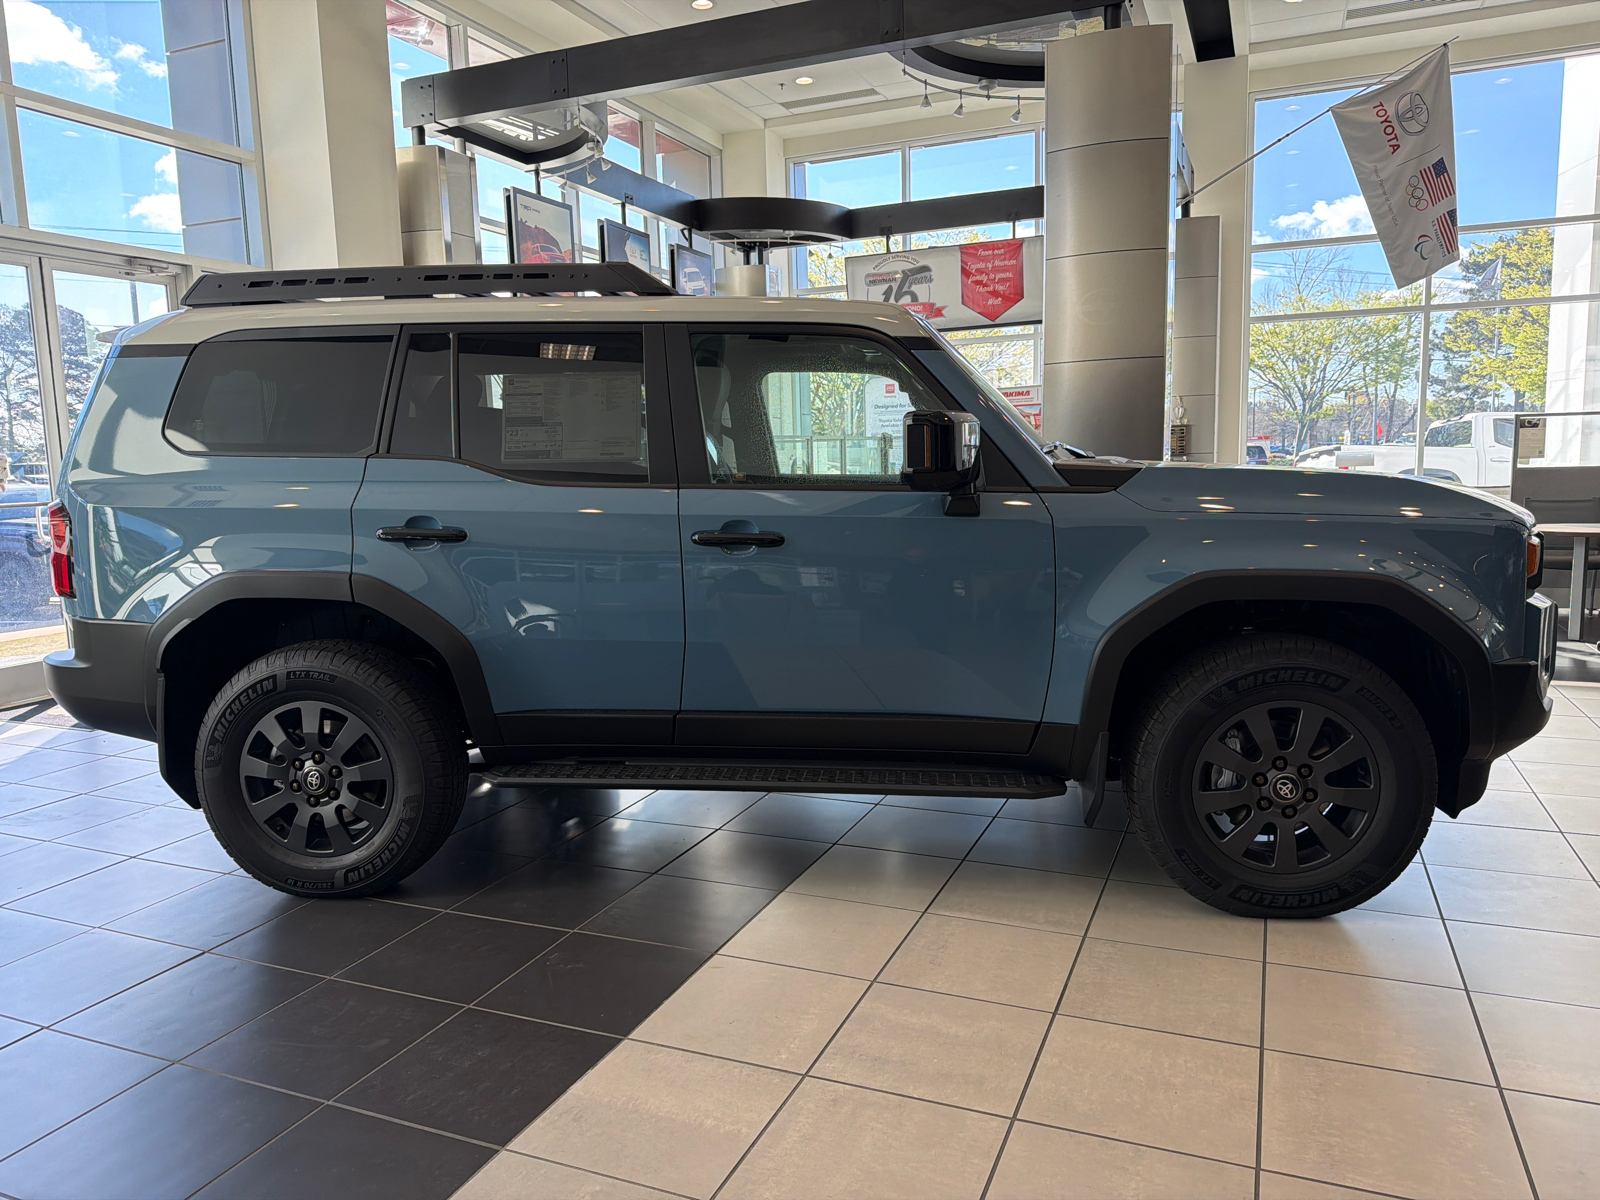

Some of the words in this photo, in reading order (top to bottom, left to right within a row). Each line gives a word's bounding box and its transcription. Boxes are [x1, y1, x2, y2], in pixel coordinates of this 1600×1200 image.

[1372, 102, 1400, 155] TOYOTA
[1379, 179, 1388, 196] Partner
[1386, 202, 1394, 215] Team
[1434, 228, 1446, 257] PARALYMPICS
[873, 256, 890, 270] PROUDLY
[967, 263, 985, 272] Toyota
[987, 260, 993, 270] of
[908, 274, 934, 289] years
[968, 274, 987, 284] family
[308, 672, 330, 681] TRAIL
[1237, 670, 1344, 692] MICHELIN
[214, 678, 274, 742] MICHELIN
[349, 822, 410, 882] MICHELIN
[1181, 854, 1199, 874] TRAIL
[1198, 872, 1217, 888] LTX
[1235, 887, 1339, 908] MICHELIN
